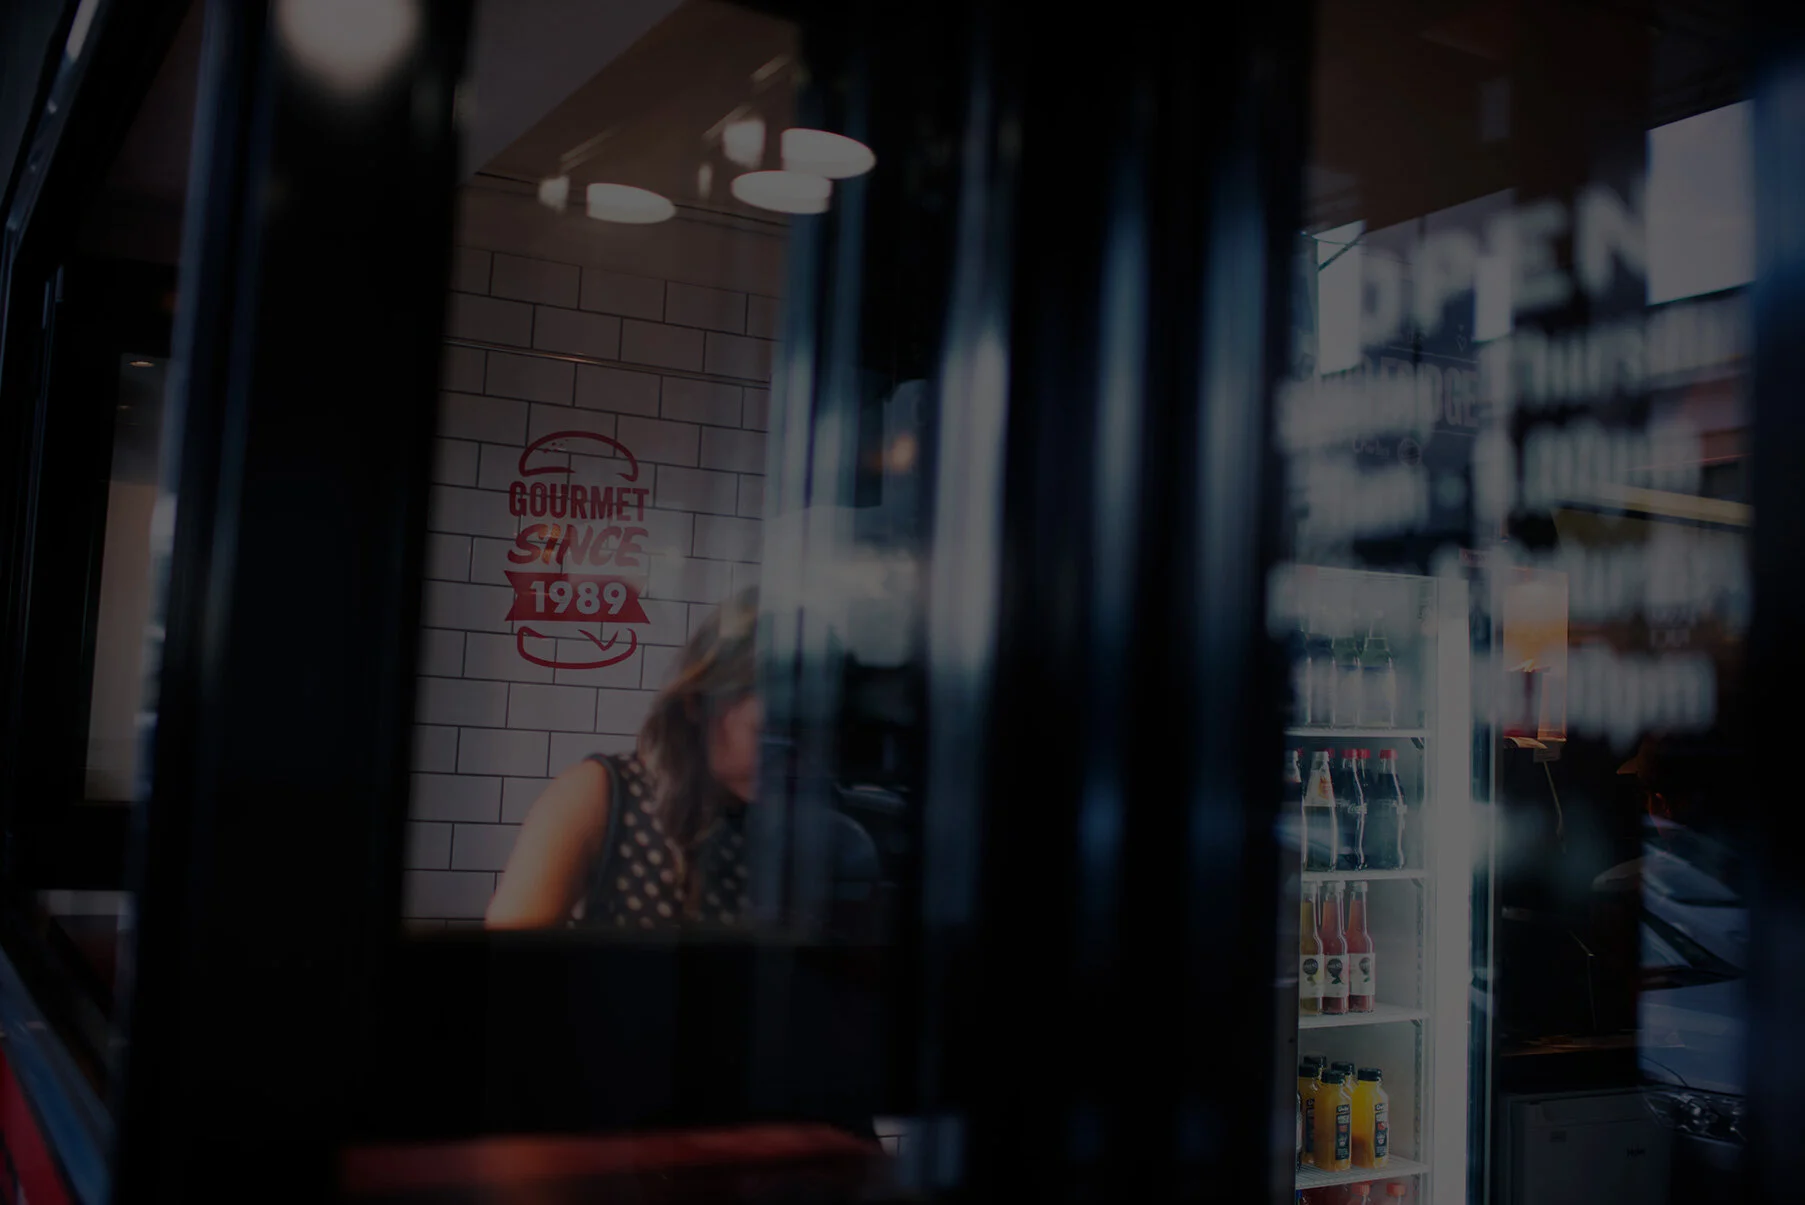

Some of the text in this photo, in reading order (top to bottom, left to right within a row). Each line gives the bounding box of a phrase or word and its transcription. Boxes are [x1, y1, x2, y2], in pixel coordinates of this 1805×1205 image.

[508, 480, 650, 522] GOURMET
[507, 523, 649, 566] SINCE
[529, 580, 627, 615] 1989
